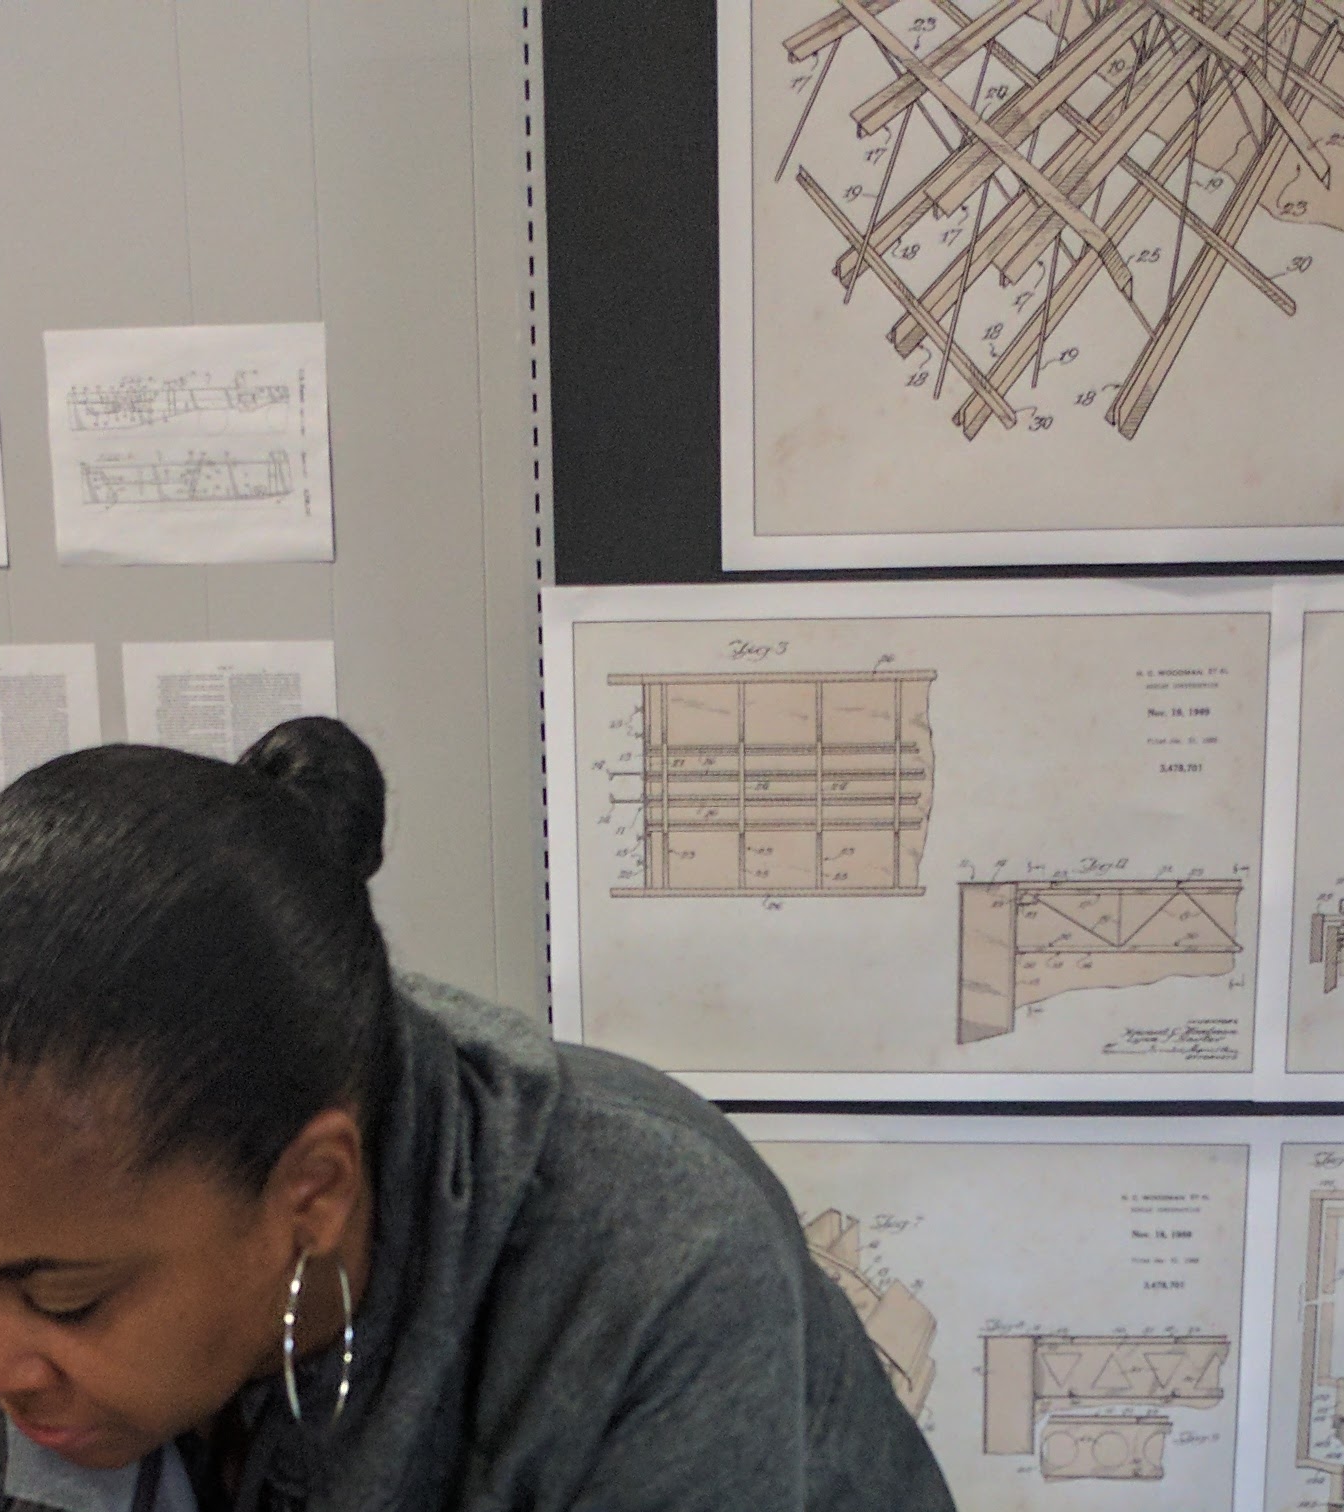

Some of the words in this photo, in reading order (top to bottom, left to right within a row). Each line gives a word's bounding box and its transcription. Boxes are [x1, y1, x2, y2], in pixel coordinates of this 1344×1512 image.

[908, 16, 937, 32] 23
[1135, 247, 1160, 263] 25
[1286, 255, 1313, 273] 30
[982, 322, 1004, 341] 18
[906, 371, 929, 387] 18
[1074, 389, 1097, 406] 18
[1028, 414, 1054, 431] 30
